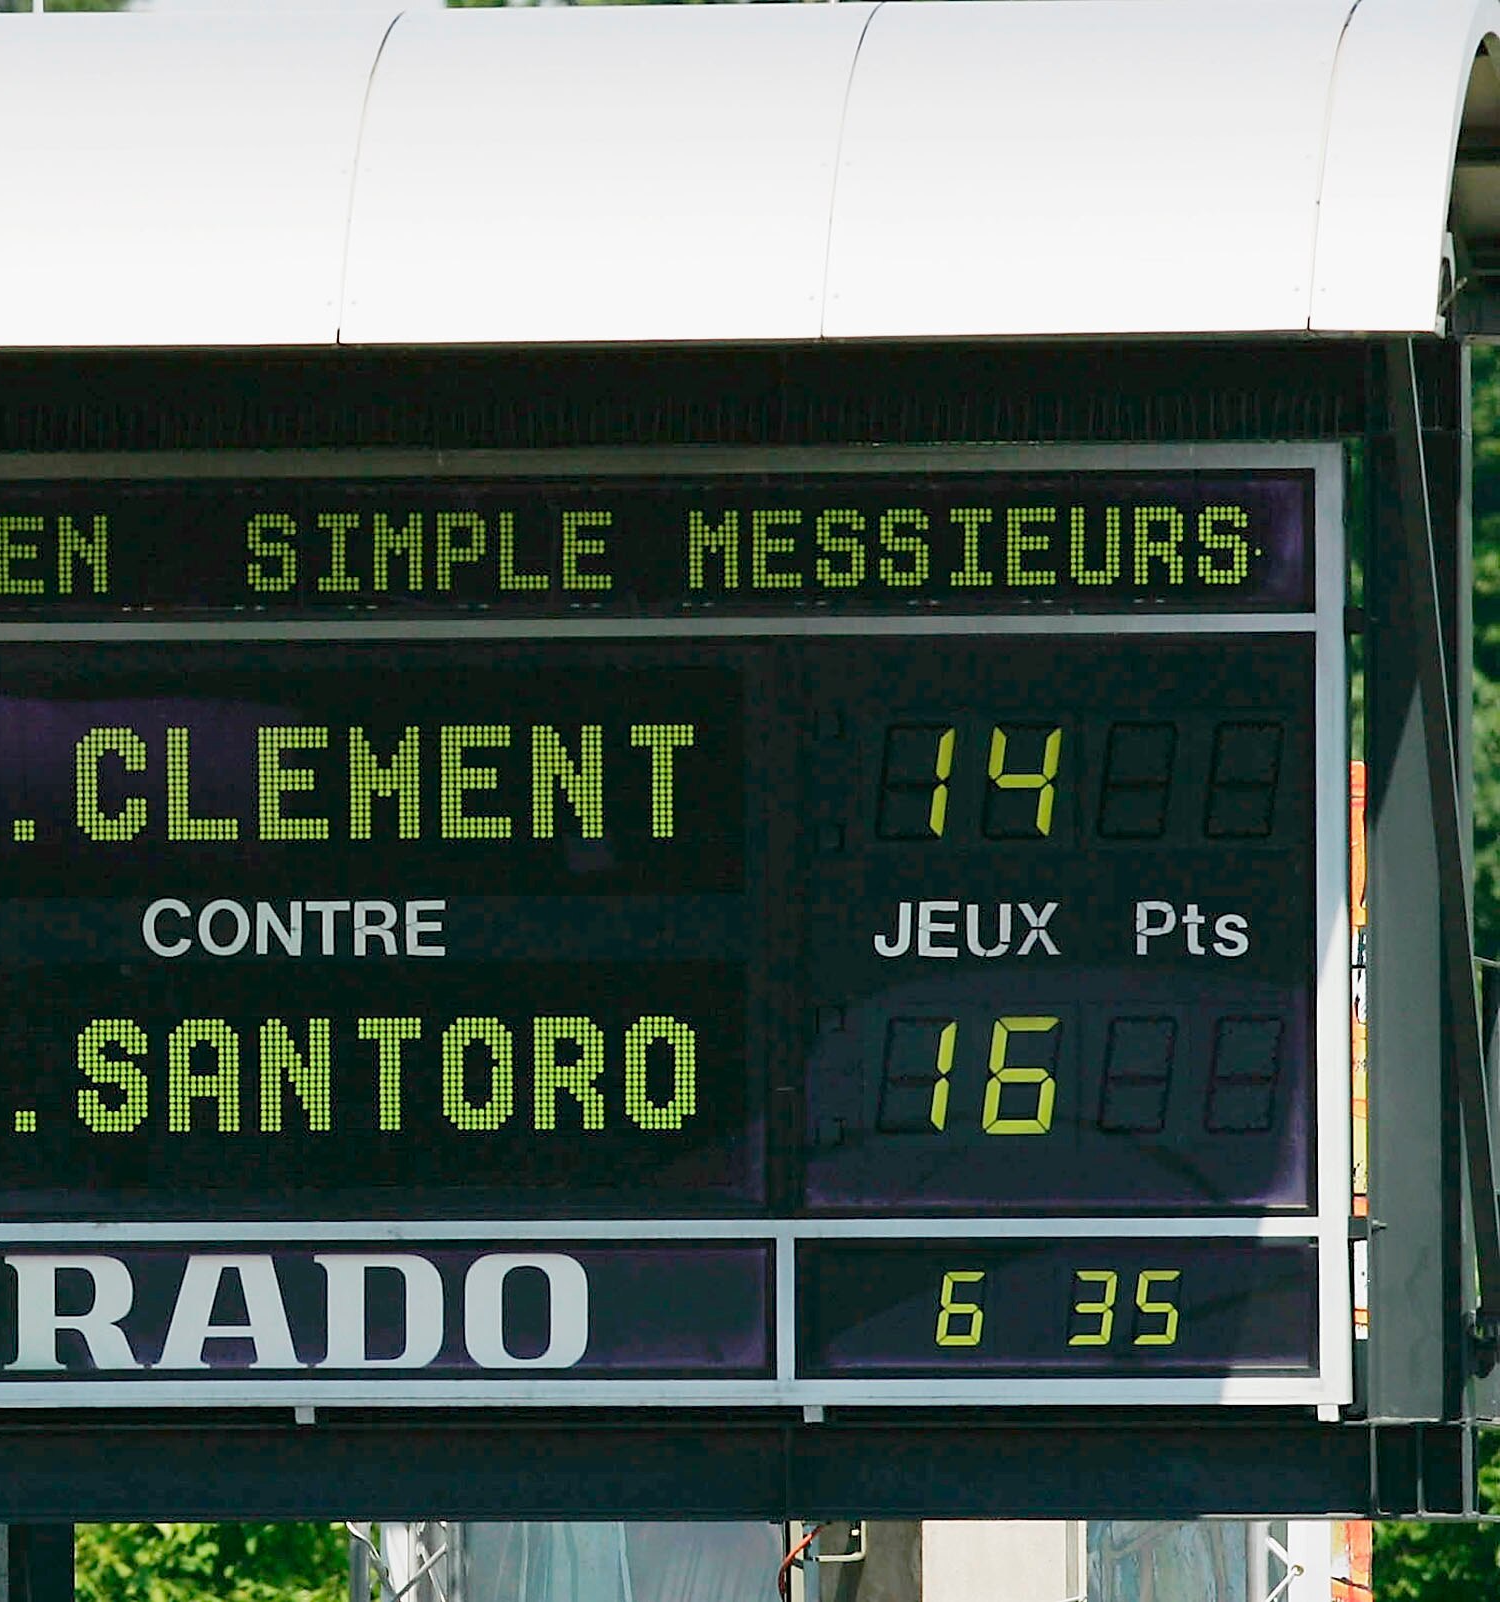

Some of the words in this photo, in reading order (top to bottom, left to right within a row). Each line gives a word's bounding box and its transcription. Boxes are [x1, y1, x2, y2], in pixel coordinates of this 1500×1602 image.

[248, 511, 614, 592] SIMPLE
[690, 507, 1250, 590] MESSIEURS
[930, 727, 1063, 838] 14
[143, 899, 448, 959] CONTRE
[875, 901, 1062, 959] JEUX
[1137, 901, 1251, 959] Pts
[932, 1017, 1060, 1136] 16
[6, 1254, 590, 1371] RADO
[937, 1272, 985, 1347] 6
[1071, 1271, 1180, 1347] 35
